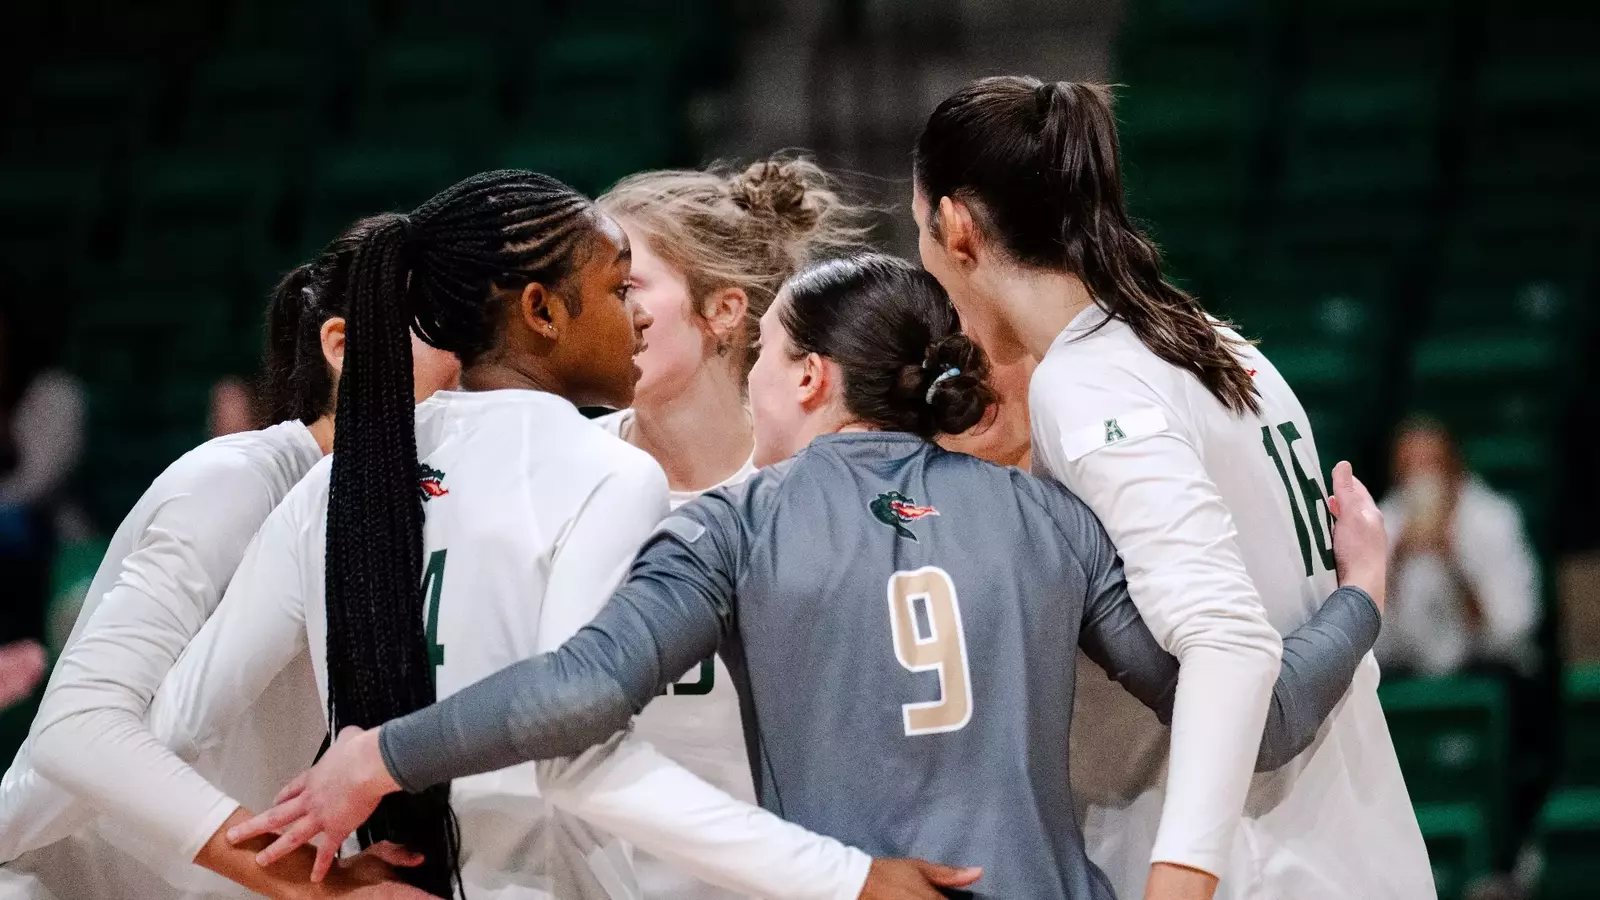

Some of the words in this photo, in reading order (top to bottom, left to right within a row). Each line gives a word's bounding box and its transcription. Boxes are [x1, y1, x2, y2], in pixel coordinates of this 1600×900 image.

[1104, 418, 1127, 443] A
[1261, 420, 1336, 577] 16
[887, 565, 973, 736] 9
